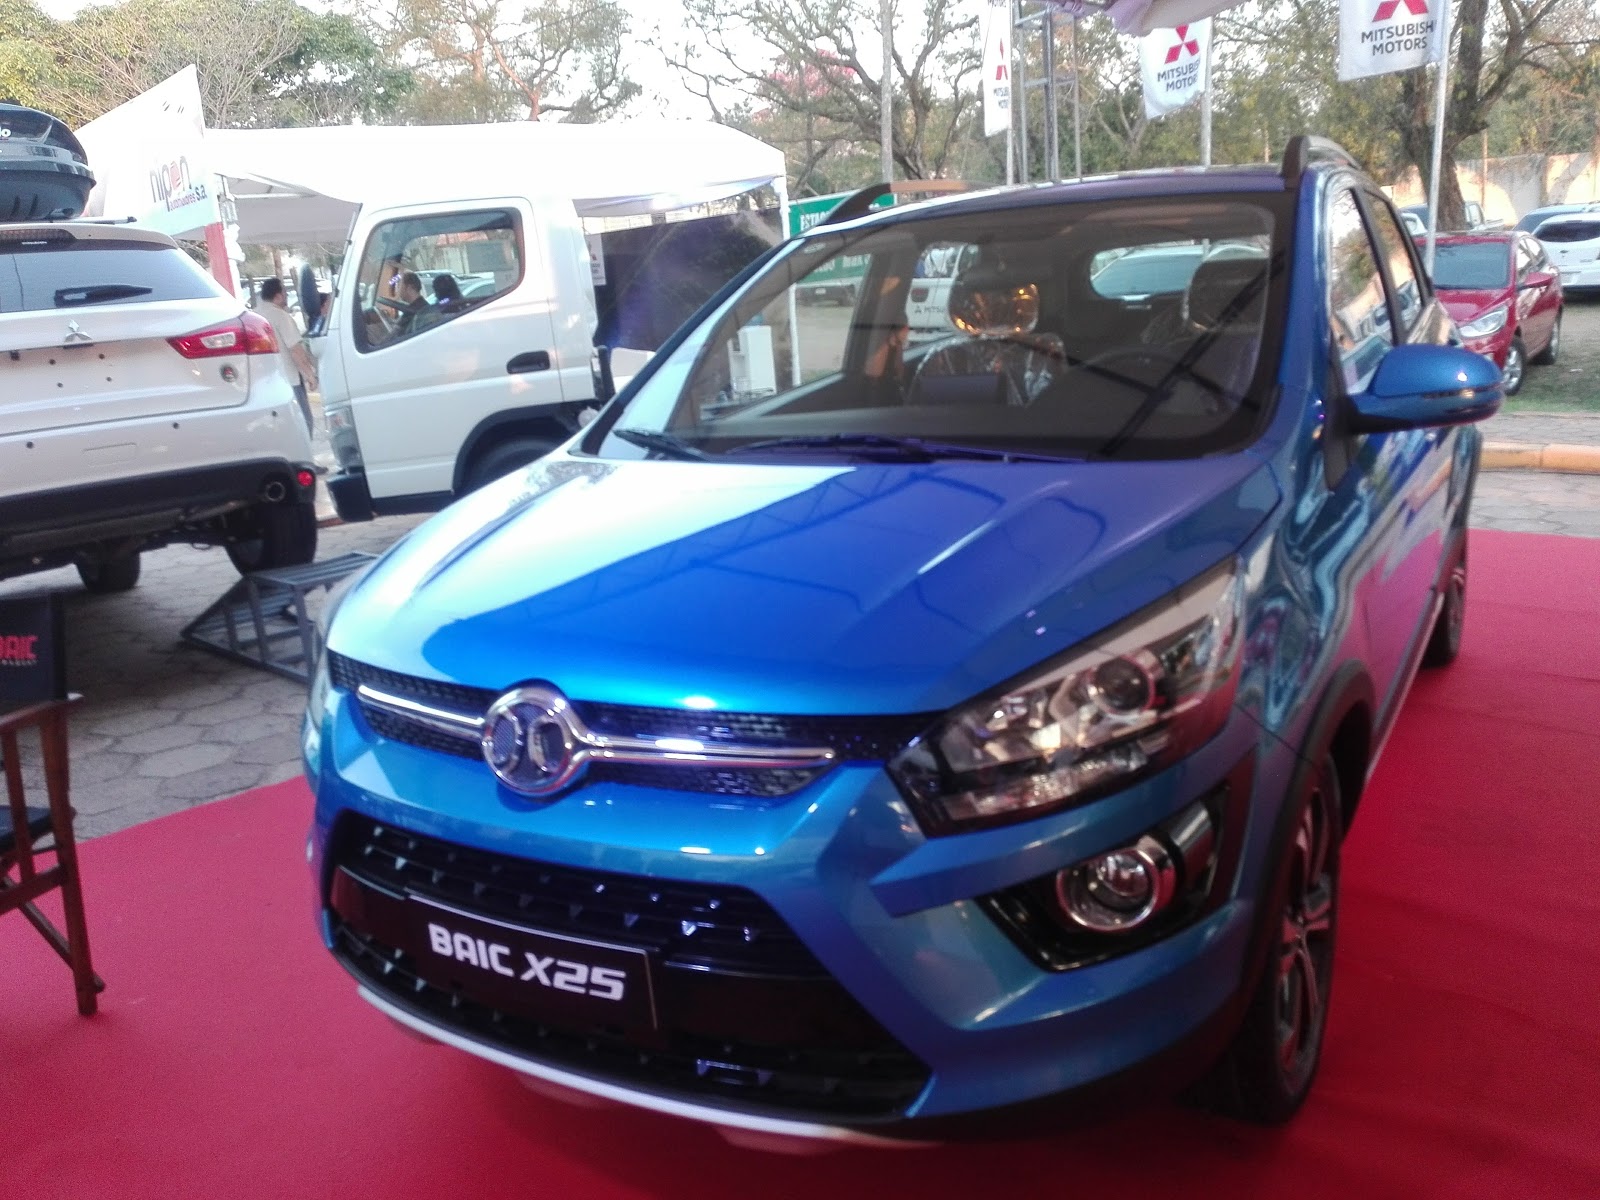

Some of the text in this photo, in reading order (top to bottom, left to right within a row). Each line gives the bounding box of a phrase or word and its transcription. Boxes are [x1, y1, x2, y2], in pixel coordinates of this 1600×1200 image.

[1361, 20, 1435, 43] MITSUBISH
[1372, 36, 1428, 56] MOTORS
[428, 922, 626, 1001] BAIC X25
